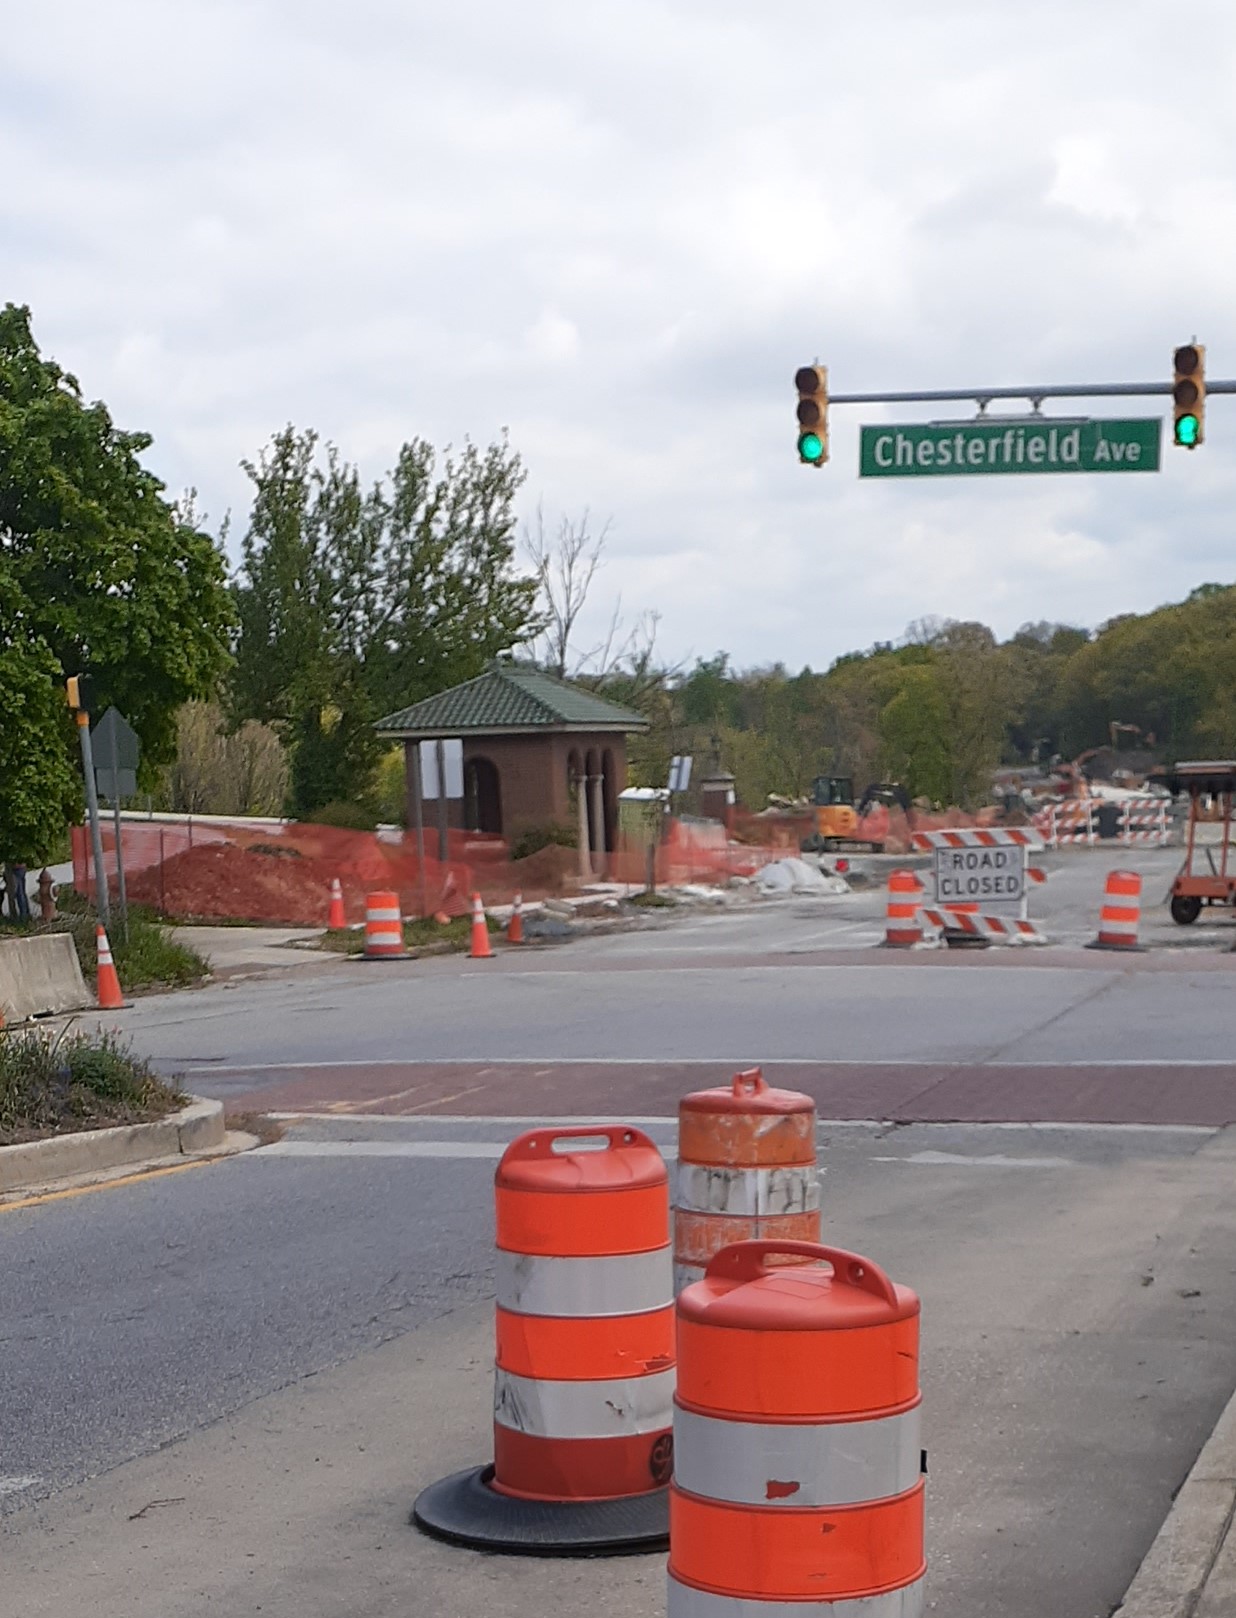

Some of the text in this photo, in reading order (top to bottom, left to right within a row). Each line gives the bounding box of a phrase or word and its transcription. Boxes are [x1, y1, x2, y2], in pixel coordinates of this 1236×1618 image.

[874, 429, 1142, 467] Chesterfield Ave
[953, 852, 1007, 870] ROAD
[941, 876, 1019, 895] CLOSED
